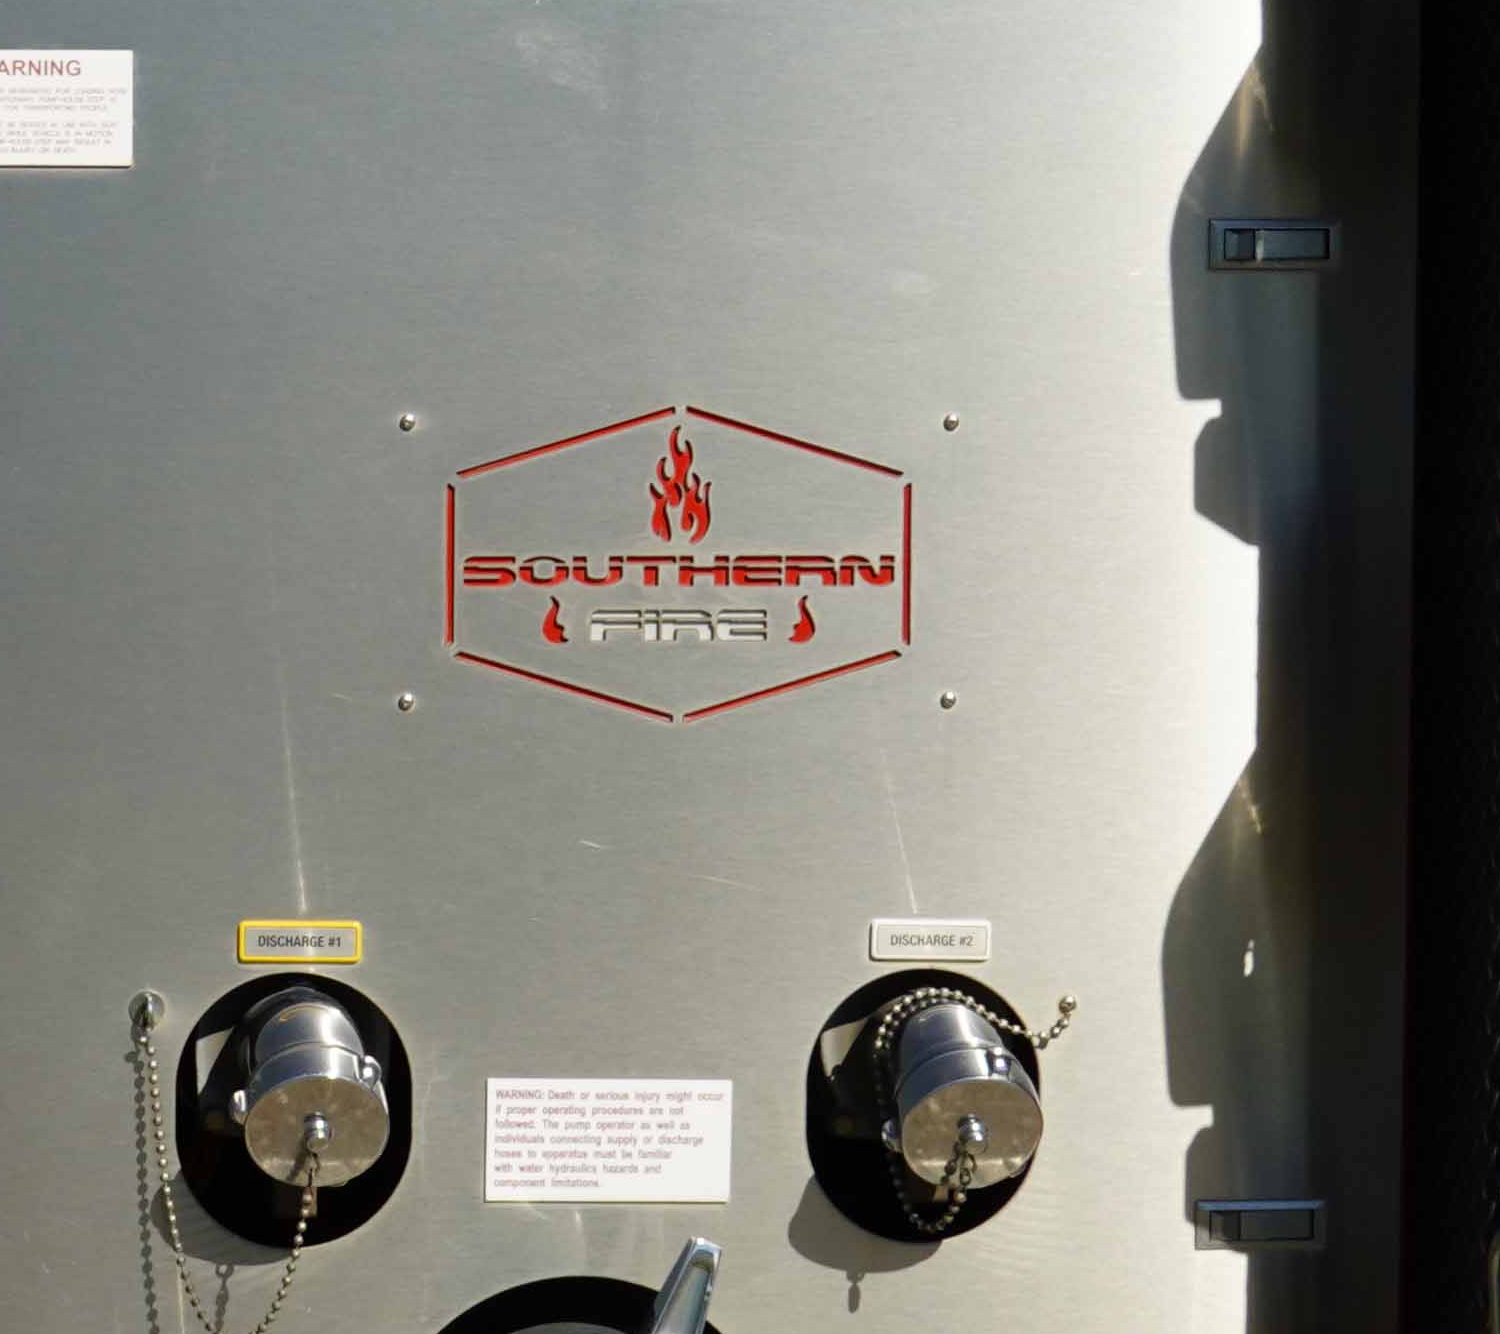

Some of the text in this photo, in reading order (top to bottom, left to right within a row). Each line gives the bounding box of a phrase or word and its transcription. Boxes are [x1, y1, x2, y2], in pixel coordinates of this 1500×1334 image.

[463, 555, 896, 587] SOUTHERN
[589, 608, 768, 643] FIRE
[258, 935, 341, 947] DISCHARGE #1
[890, 934, 974, 946] DISCHARGE #2
[496, 1090, 723, 1102] WARNING: Death or serious injury might occur
[507, 1105, 536, 1116] proper
[543, 1105, 586, 1116] operating
[592, 1105, 643, 1116] procedures
[649, 1107, 663, 1115] are
[669, 1105, 683, 1115] not
[543, 1119, 559, 1129] The
[565, 1119, 590, 1130] pump
[596, 1119, 634, 1130] operator
[640, 1121, 651, 1129] as
[657, 1119, 674, 1129] well
[680, 1121, 690, 1129] as
[494, 1134, 704, 1146] individuals connecting supply or discharge
[494, 1149, 671, 1160] hoses to apparatus must be familiar
[494, 1163, 661, 1174] with water hydraulics hazards and
[494, 1178, 545, 1188] component
